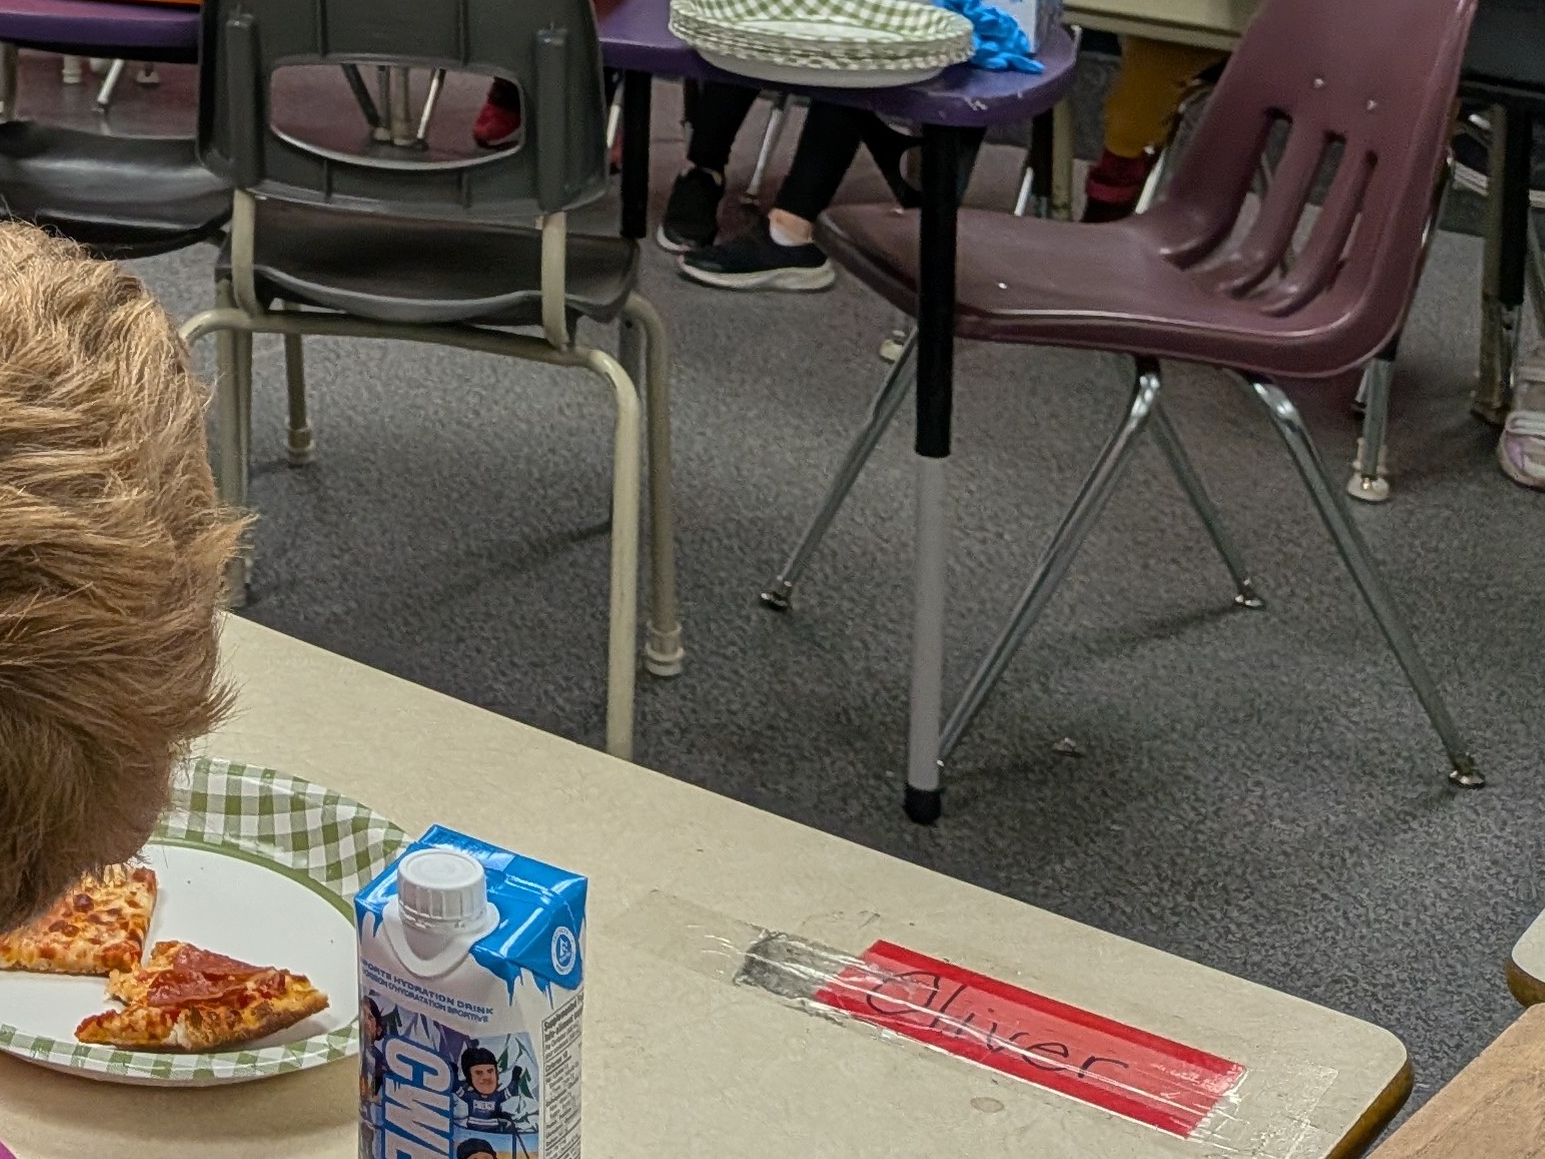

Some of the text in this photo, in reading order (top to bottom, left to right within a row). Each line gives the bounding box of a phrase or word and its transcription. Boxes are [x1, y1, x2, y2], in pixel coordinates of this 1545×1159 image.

[393, 975, 456, 1006] HYDRATION
[457, 999, 494, 1016] DRINK
[447, 1005, 489, 1024] SPORTIVE
[866, 970, 1128, 1079] Oliver
